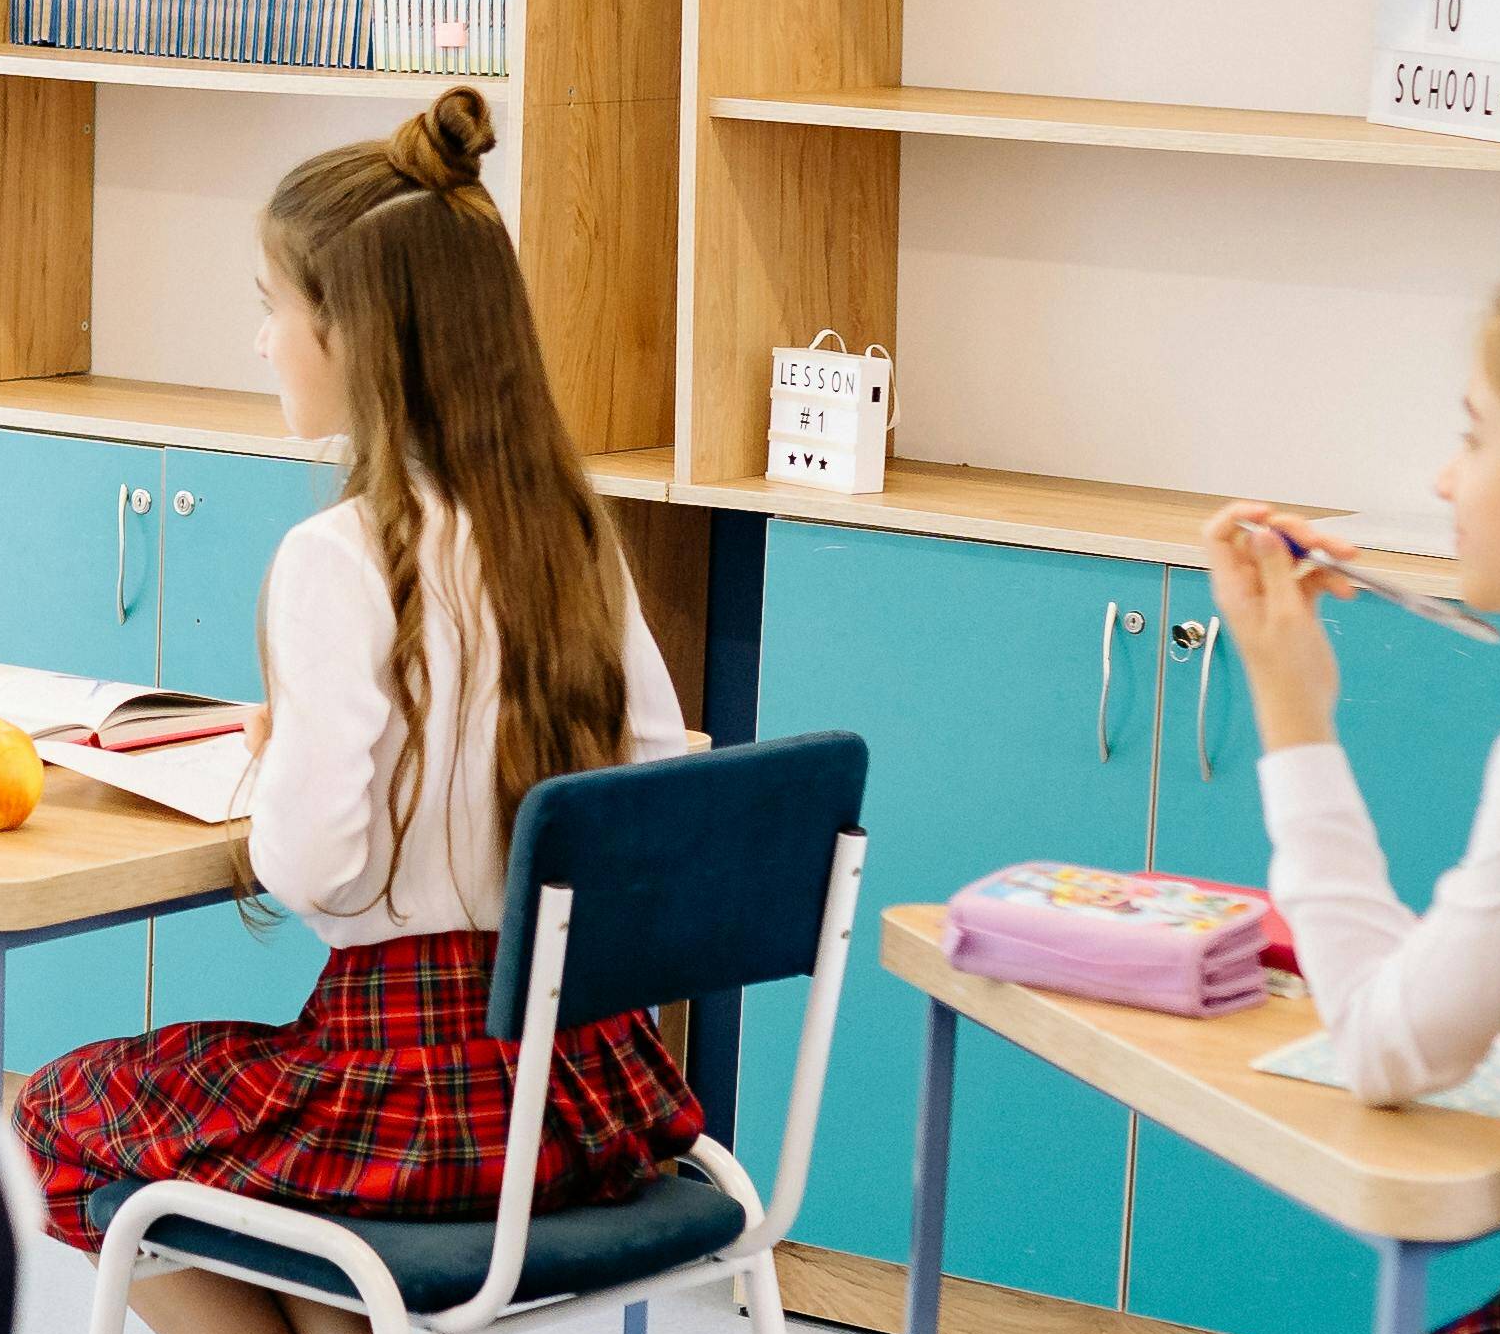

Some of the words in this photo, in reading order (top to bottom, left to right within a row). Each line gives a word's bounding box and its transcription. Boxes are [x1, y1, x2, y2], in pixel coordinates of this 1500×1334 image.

[1394, 63, 1494, 116] SCHOOL
[780, 362, 855, 395] LESSON
[799, 407, 826, 434] #1
